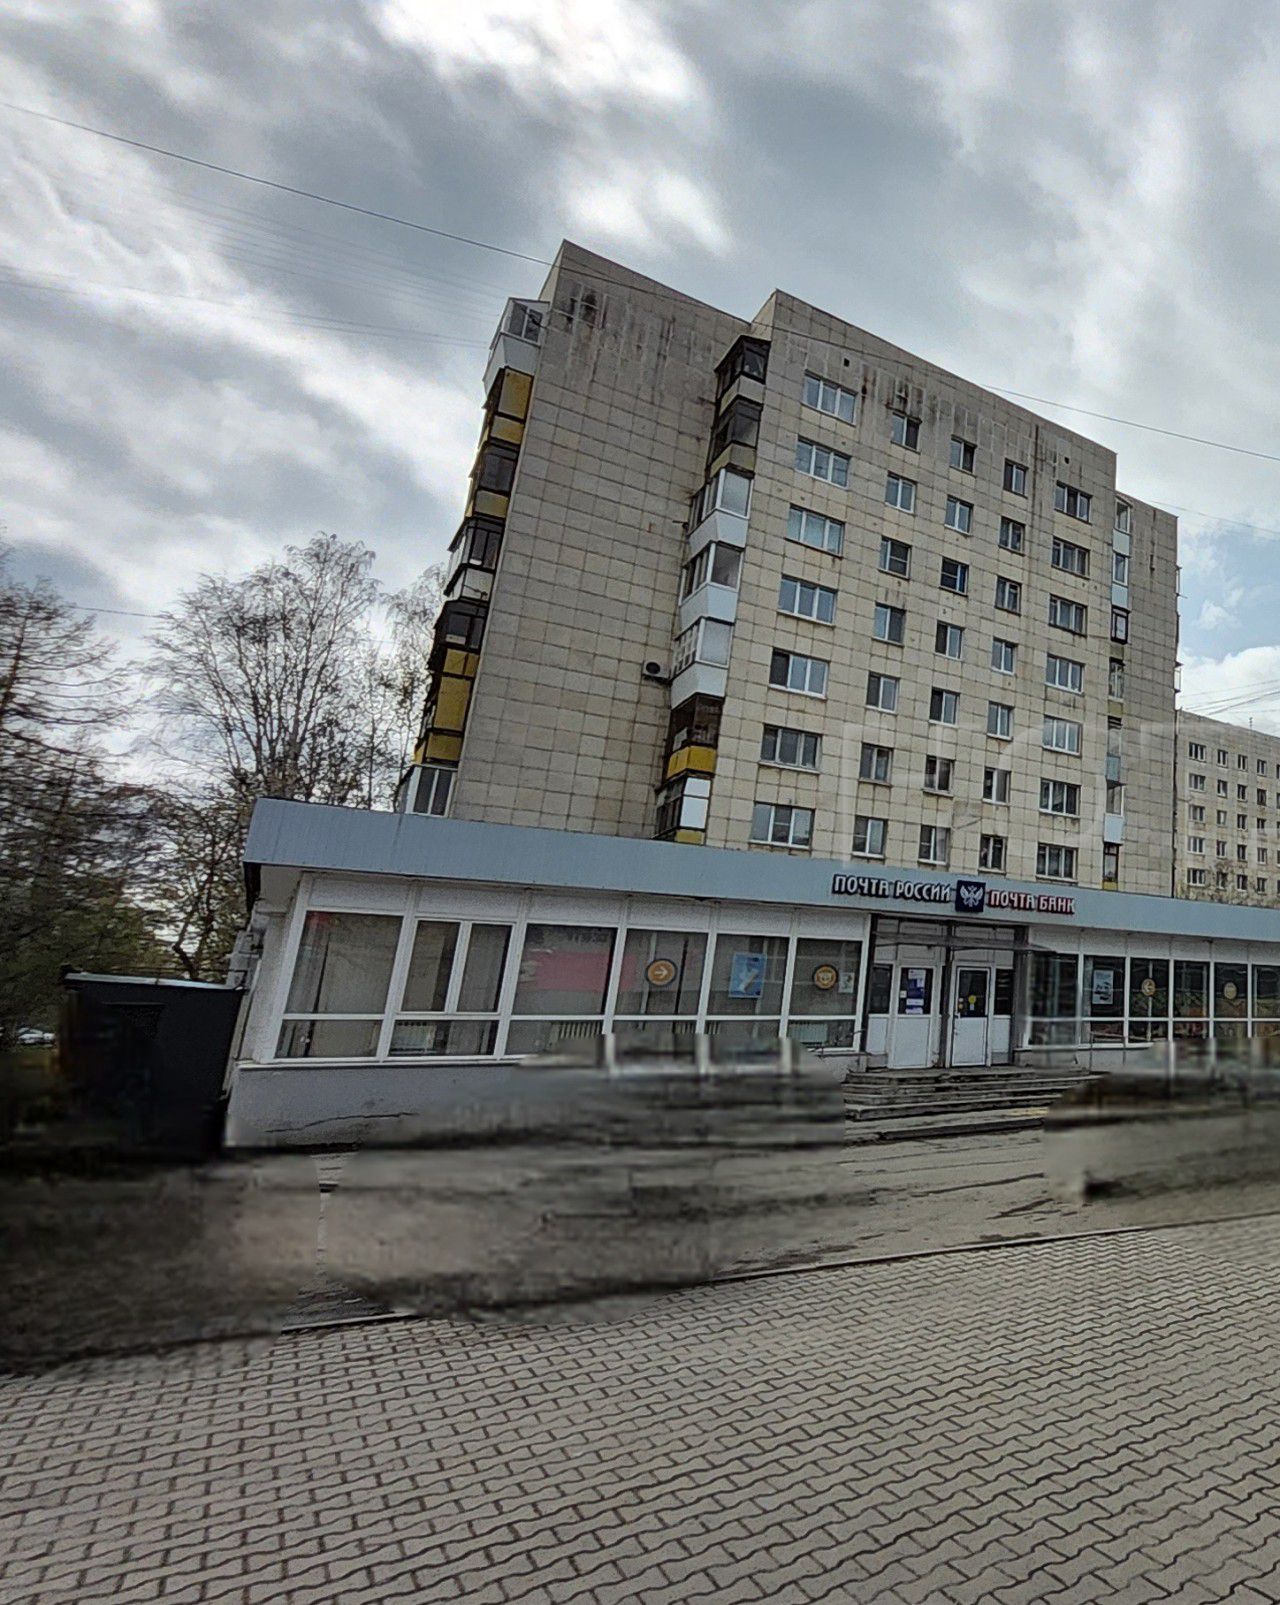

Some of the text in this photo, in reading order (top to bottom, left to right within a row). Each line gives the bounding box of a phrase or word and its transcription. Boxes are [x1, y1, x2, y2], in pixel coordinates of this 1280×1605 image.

[832, 874, 1076, 915] ПОЧТА РОССИИ ПОЧТА БАНК
